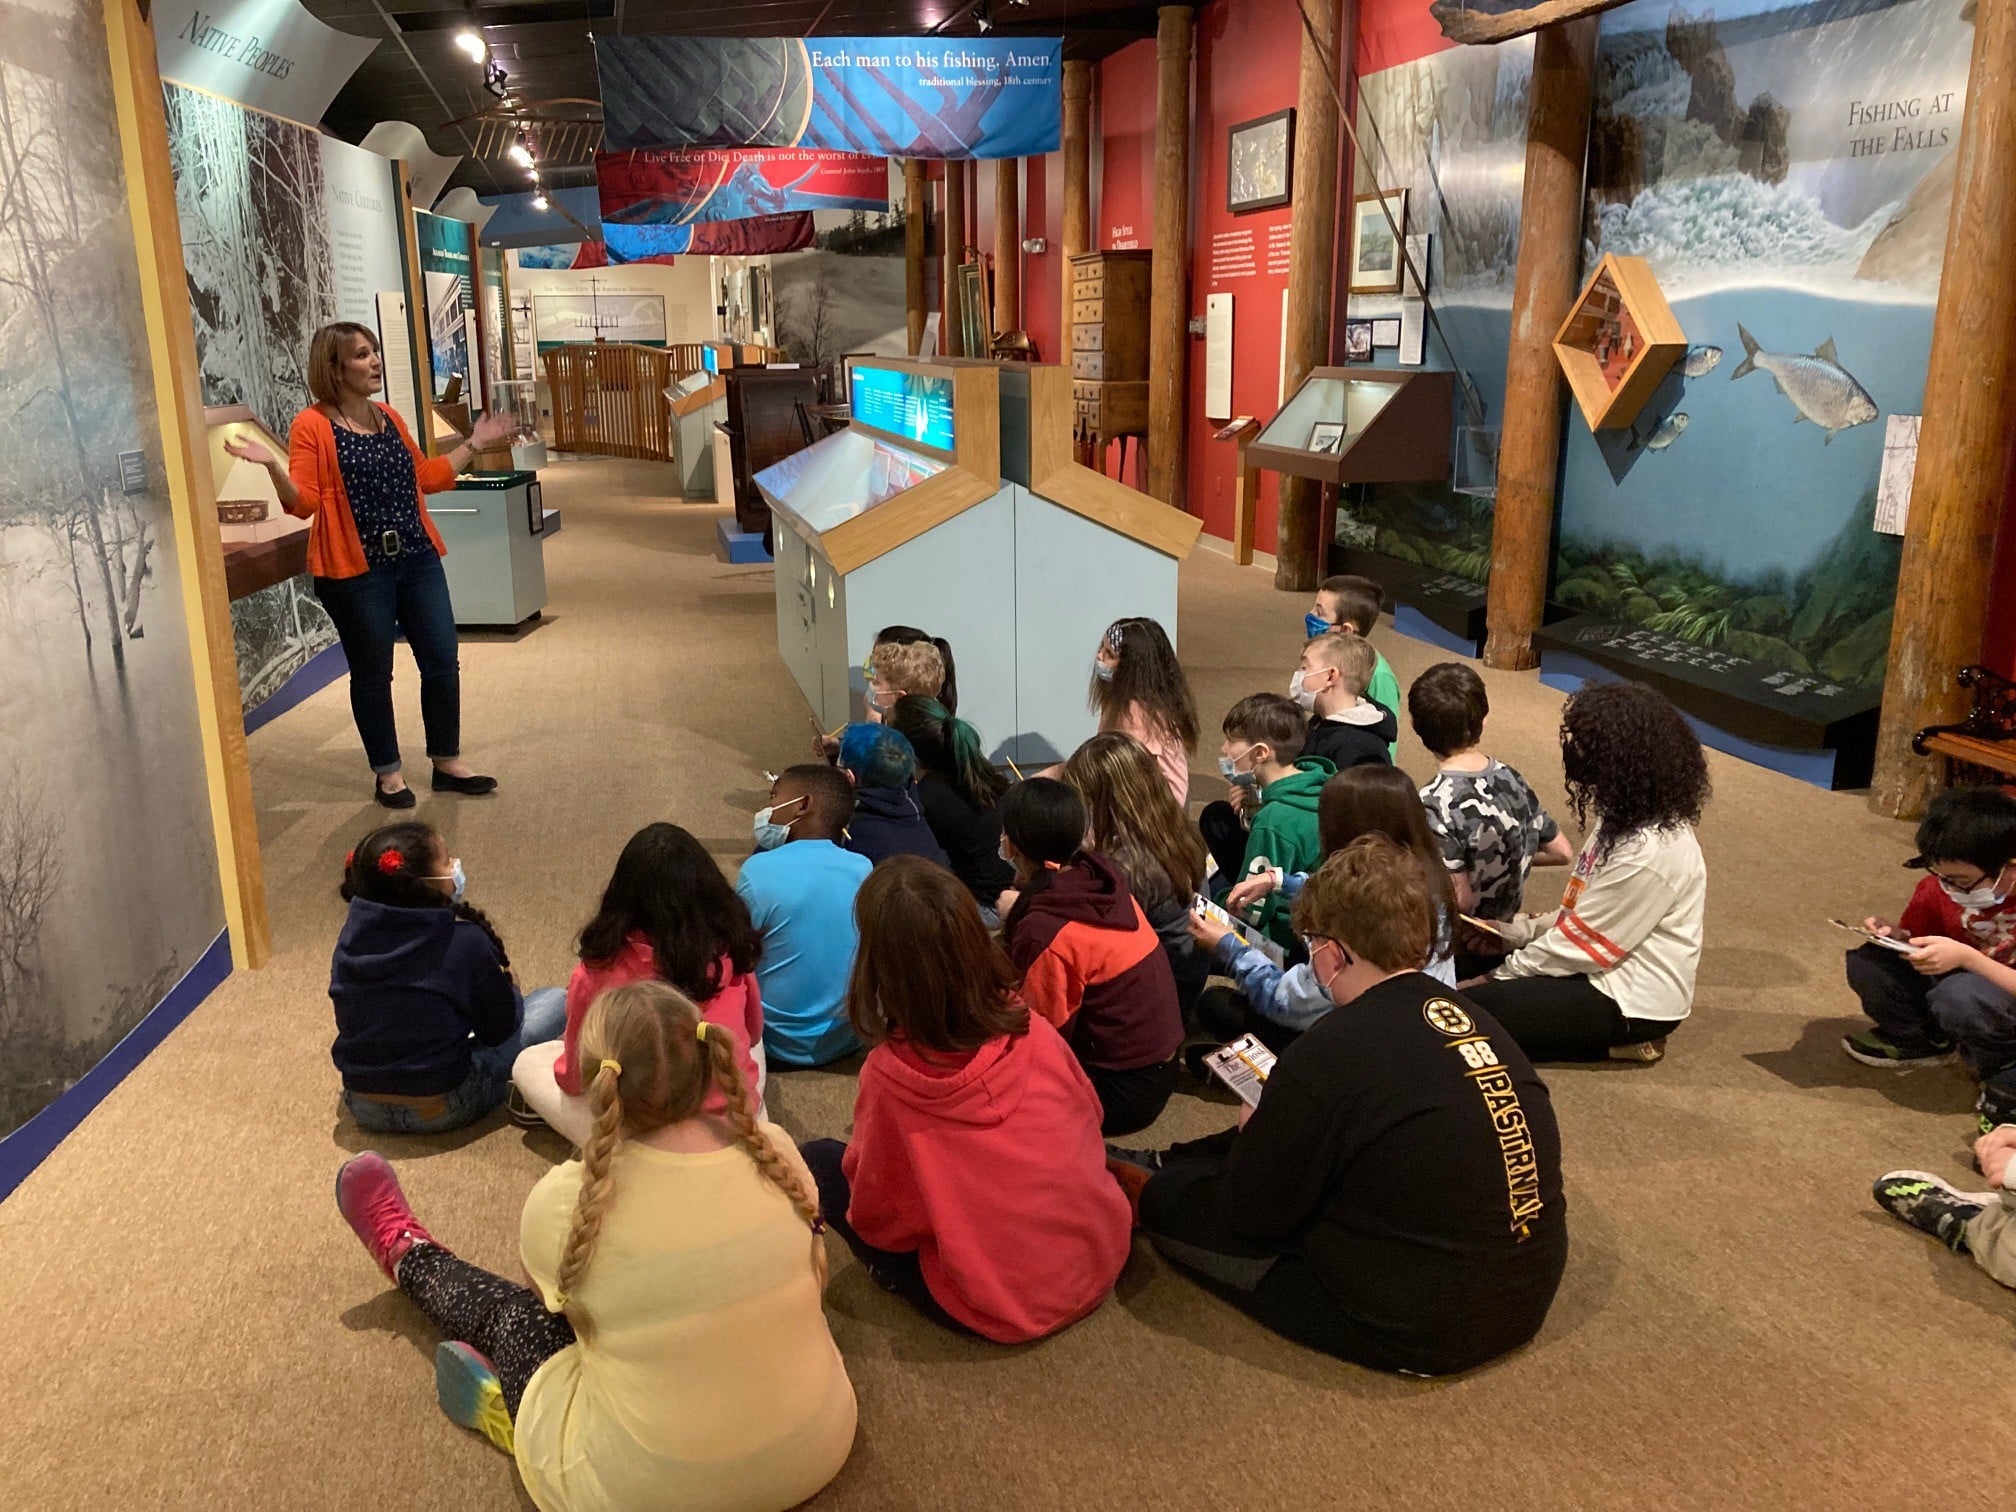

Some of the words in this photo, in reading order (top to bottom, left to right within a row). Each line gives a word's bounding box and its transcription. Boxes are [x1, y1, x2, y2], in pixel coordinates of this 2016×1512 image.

[178, 10, 242, 58] NATIVE
[237, 36, 295, 80] PEOPLES
[812, 50, 851, 67] Each
[856, 55, 891, 67] man
[895, 54, 912, 67] to
[916, 50, 939, 67] his
[943, 50, 1000, 72] fishing.
[1005, 51, 1052, 67] Amen.
[918, 76, 964, 86] traditional
[966, 76, 1002, 87] blessing,
[1004, 76, 1021, 85] 18th
[1023, 77, 1052, 87] century
[1848, 98, 1921, 127] FISHING
[1928, 92, 1955, 115] AT
[645, 152, 667, 162] Live
[669, 152, 691, 162] Free
[693, 154, 705, 162] or
[733, 150, 765, 162] Death
[767, 151, 776, 161] is
[778, 152, 795, 161] not
[798, 149, 816, 161] the
[817, 151, 845, 161] worst
[1850, 136, 1886, 157] THE
[1892, 126, 1949, 152] FALLS
[1458, 1040, 1499, 1069] 88
